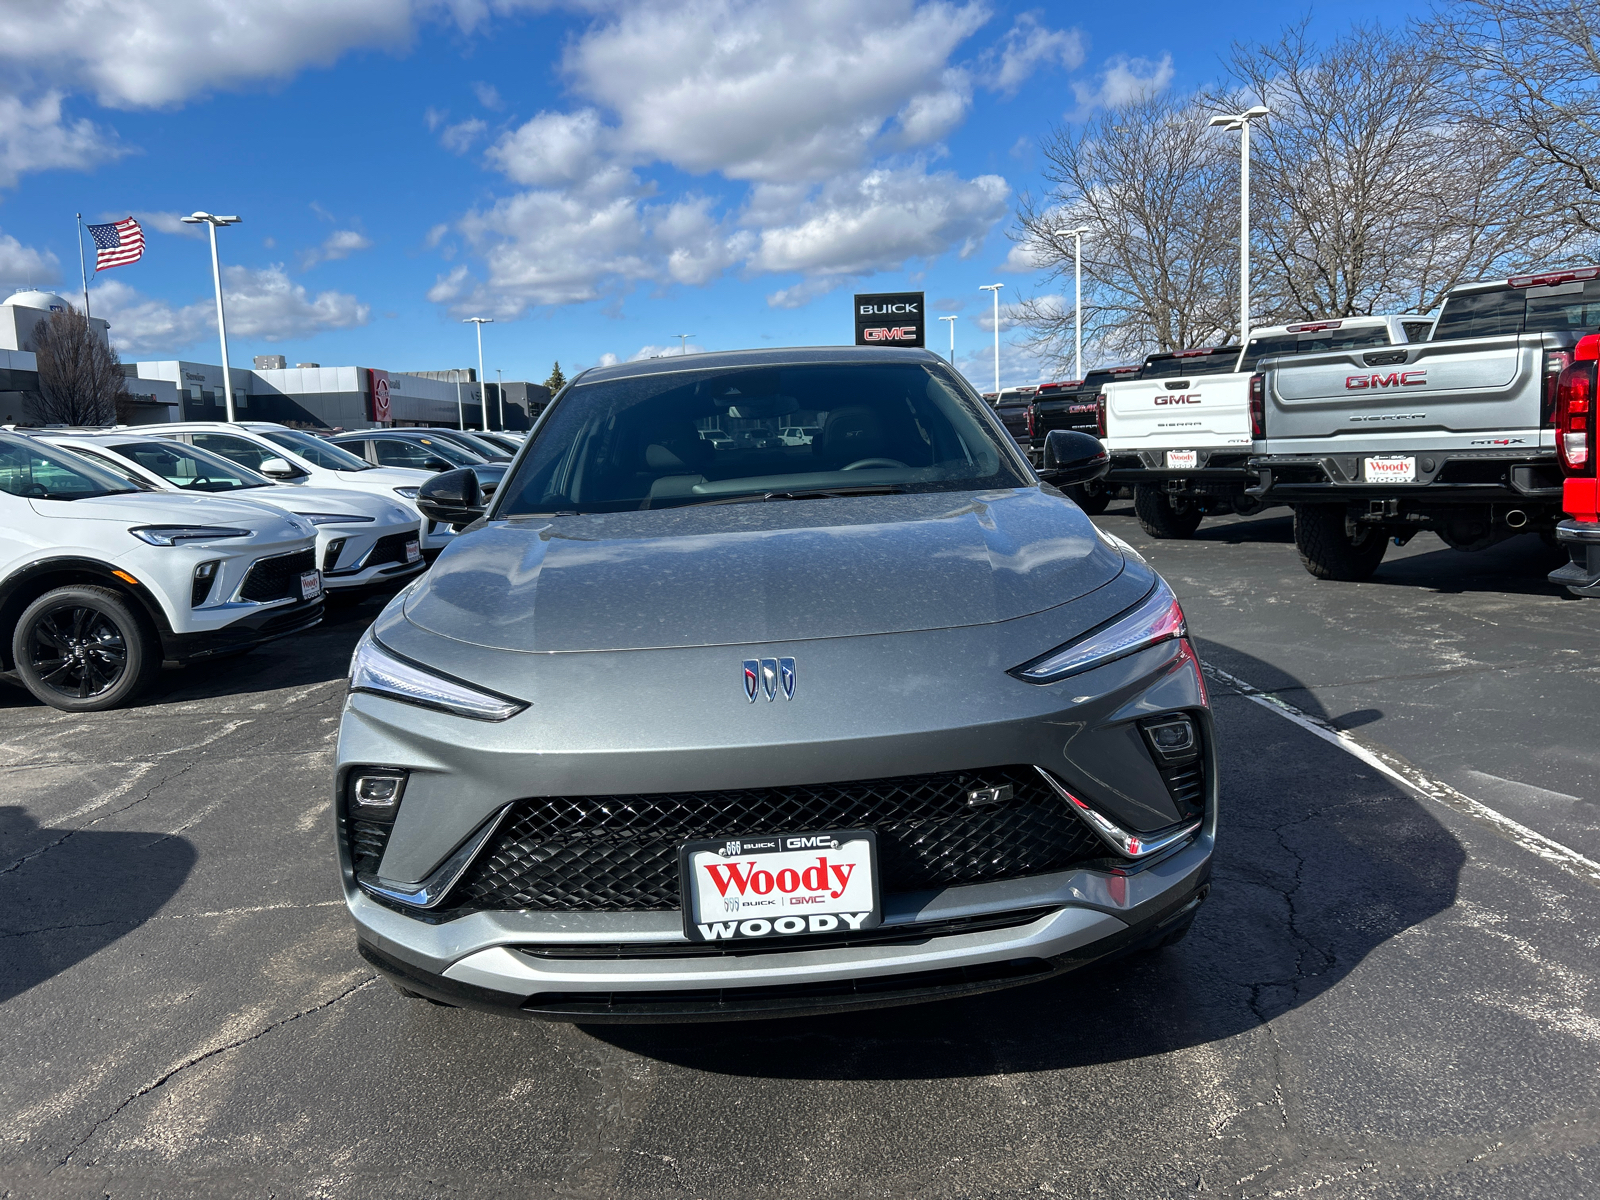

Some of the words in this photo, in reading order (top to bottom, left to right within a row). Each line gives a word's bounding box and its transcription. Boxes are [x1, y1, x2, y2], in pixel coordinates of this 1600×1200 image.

[860, 303, 919, 315] BUICK
[864, 326, 917, 341] GMC
[1345, 370, 1427, 390] GMC
[1154, 393, 1202, 406] GMC
[1349, 412, 1426, 421] SIERRA
[1470, 437, 1526, 446] AT4X
[1170, 453, 1195, 462] Woody
[1369, 461, 1411, 473] Woody
[743, 841, 775, 850] BUICK
[786, 835, 831, 849] GMC
[703, 856, 857, 899] Woody
[742, 899, 776, 907] BUICK
[789, 895, 826, 906] GMC
[697, 912, 870, 941] WOODY
